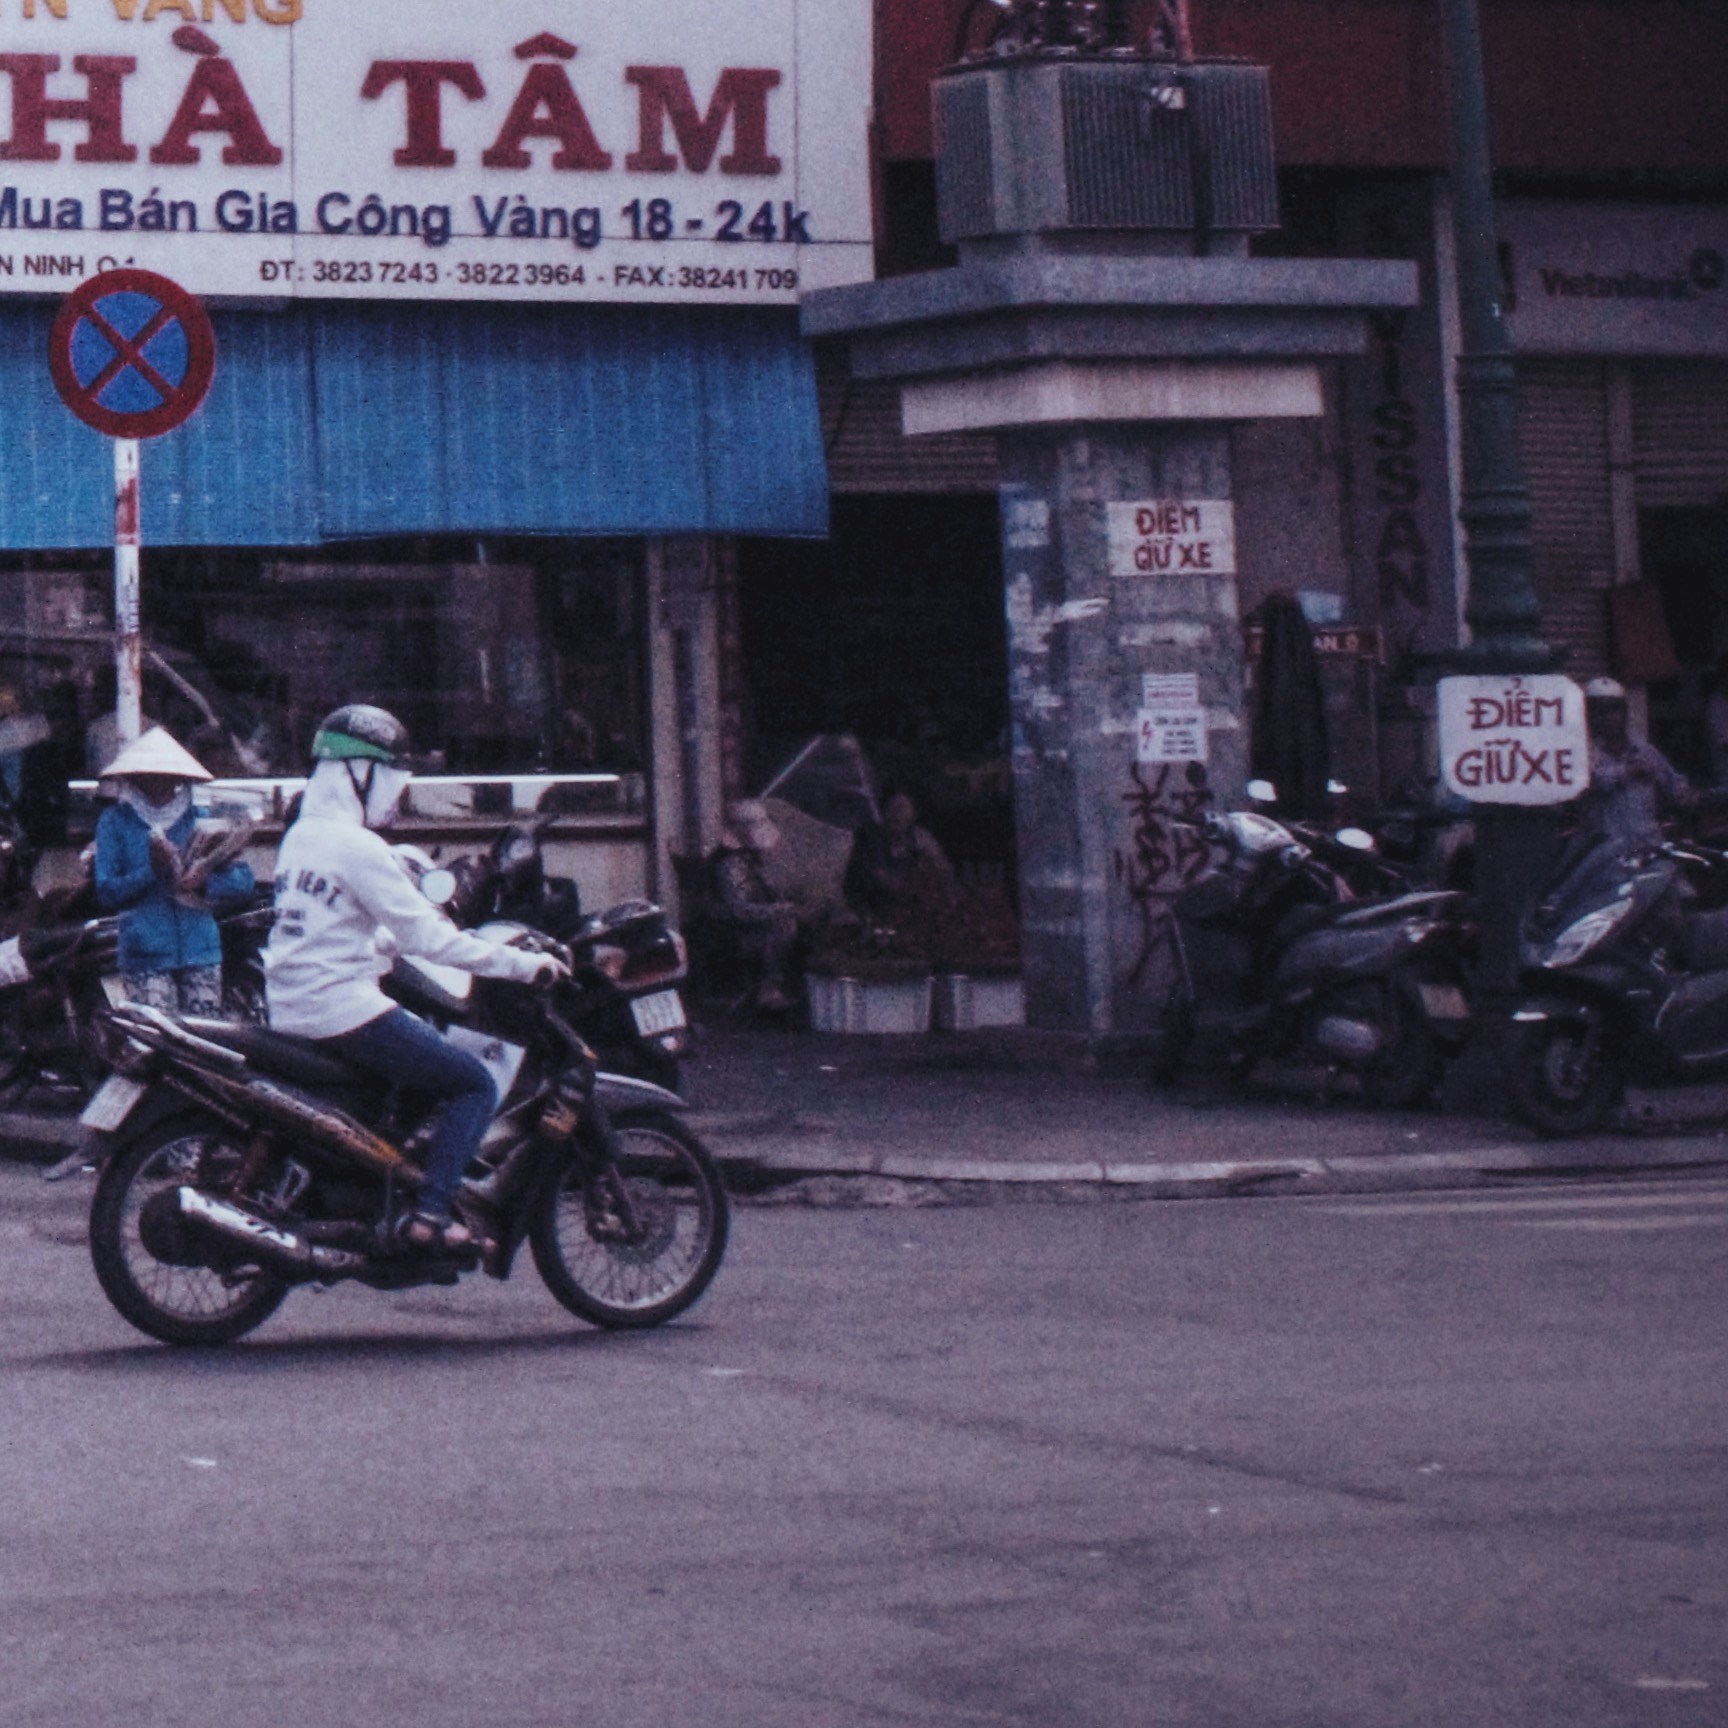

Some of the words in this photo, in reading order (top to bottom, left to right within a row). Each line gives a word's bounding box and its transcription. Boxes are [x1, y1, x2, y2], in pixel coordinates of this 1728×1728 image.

[360, 32, 783, 177] TÂM
[98, 186, 197, 232] Bán
[215, 191, 297, 235] Gia
[315, 191, 452, 246] Công
[476, 193, 602, 247] Vàng
[621, 198, 671, 239] 18
[716, 198, 811, 243] 24k
[25, 255, 85, 276] NINH
